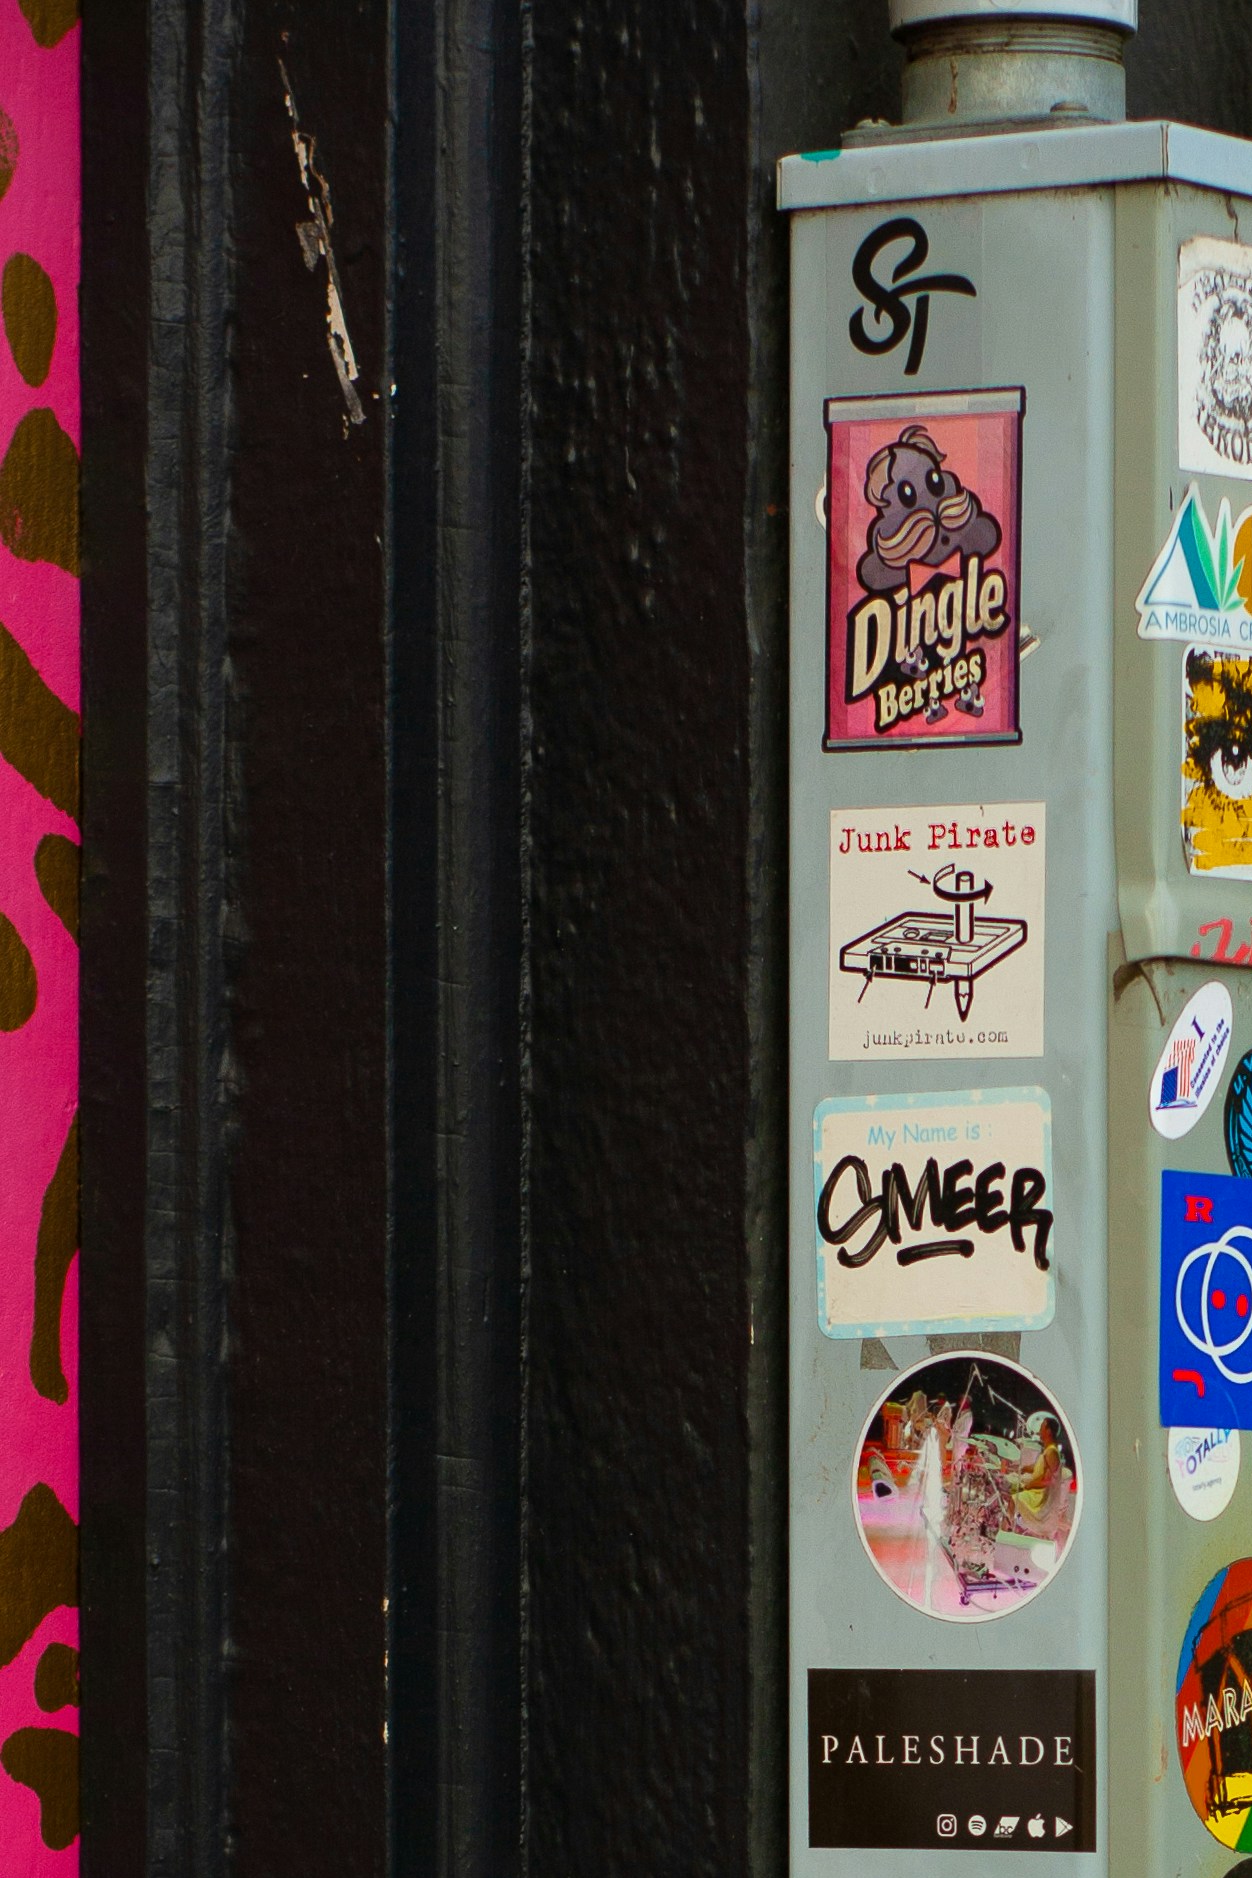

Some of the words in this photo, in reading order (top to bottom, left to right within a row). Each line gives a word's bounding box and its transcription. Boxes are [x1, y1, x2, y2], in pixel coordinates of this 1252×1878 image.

[852, 557, 1005, 698] Dingle
[1145, 611, 1231, 638] AMBROSIA
[878, 650, 984, 730] Berries
[839, 824, 911, 853] Junk
[928, 821, 1036, 850] Pirate
[863, 1029, 1009, 1048] junkpirate.com
[867, 1125, 896, 1150] My
[903, 1124, 958, 1145] Name
[817, 1155, 1053, 1271] SMEER
[821, 1735, 1075, 1766] PALESHADE
